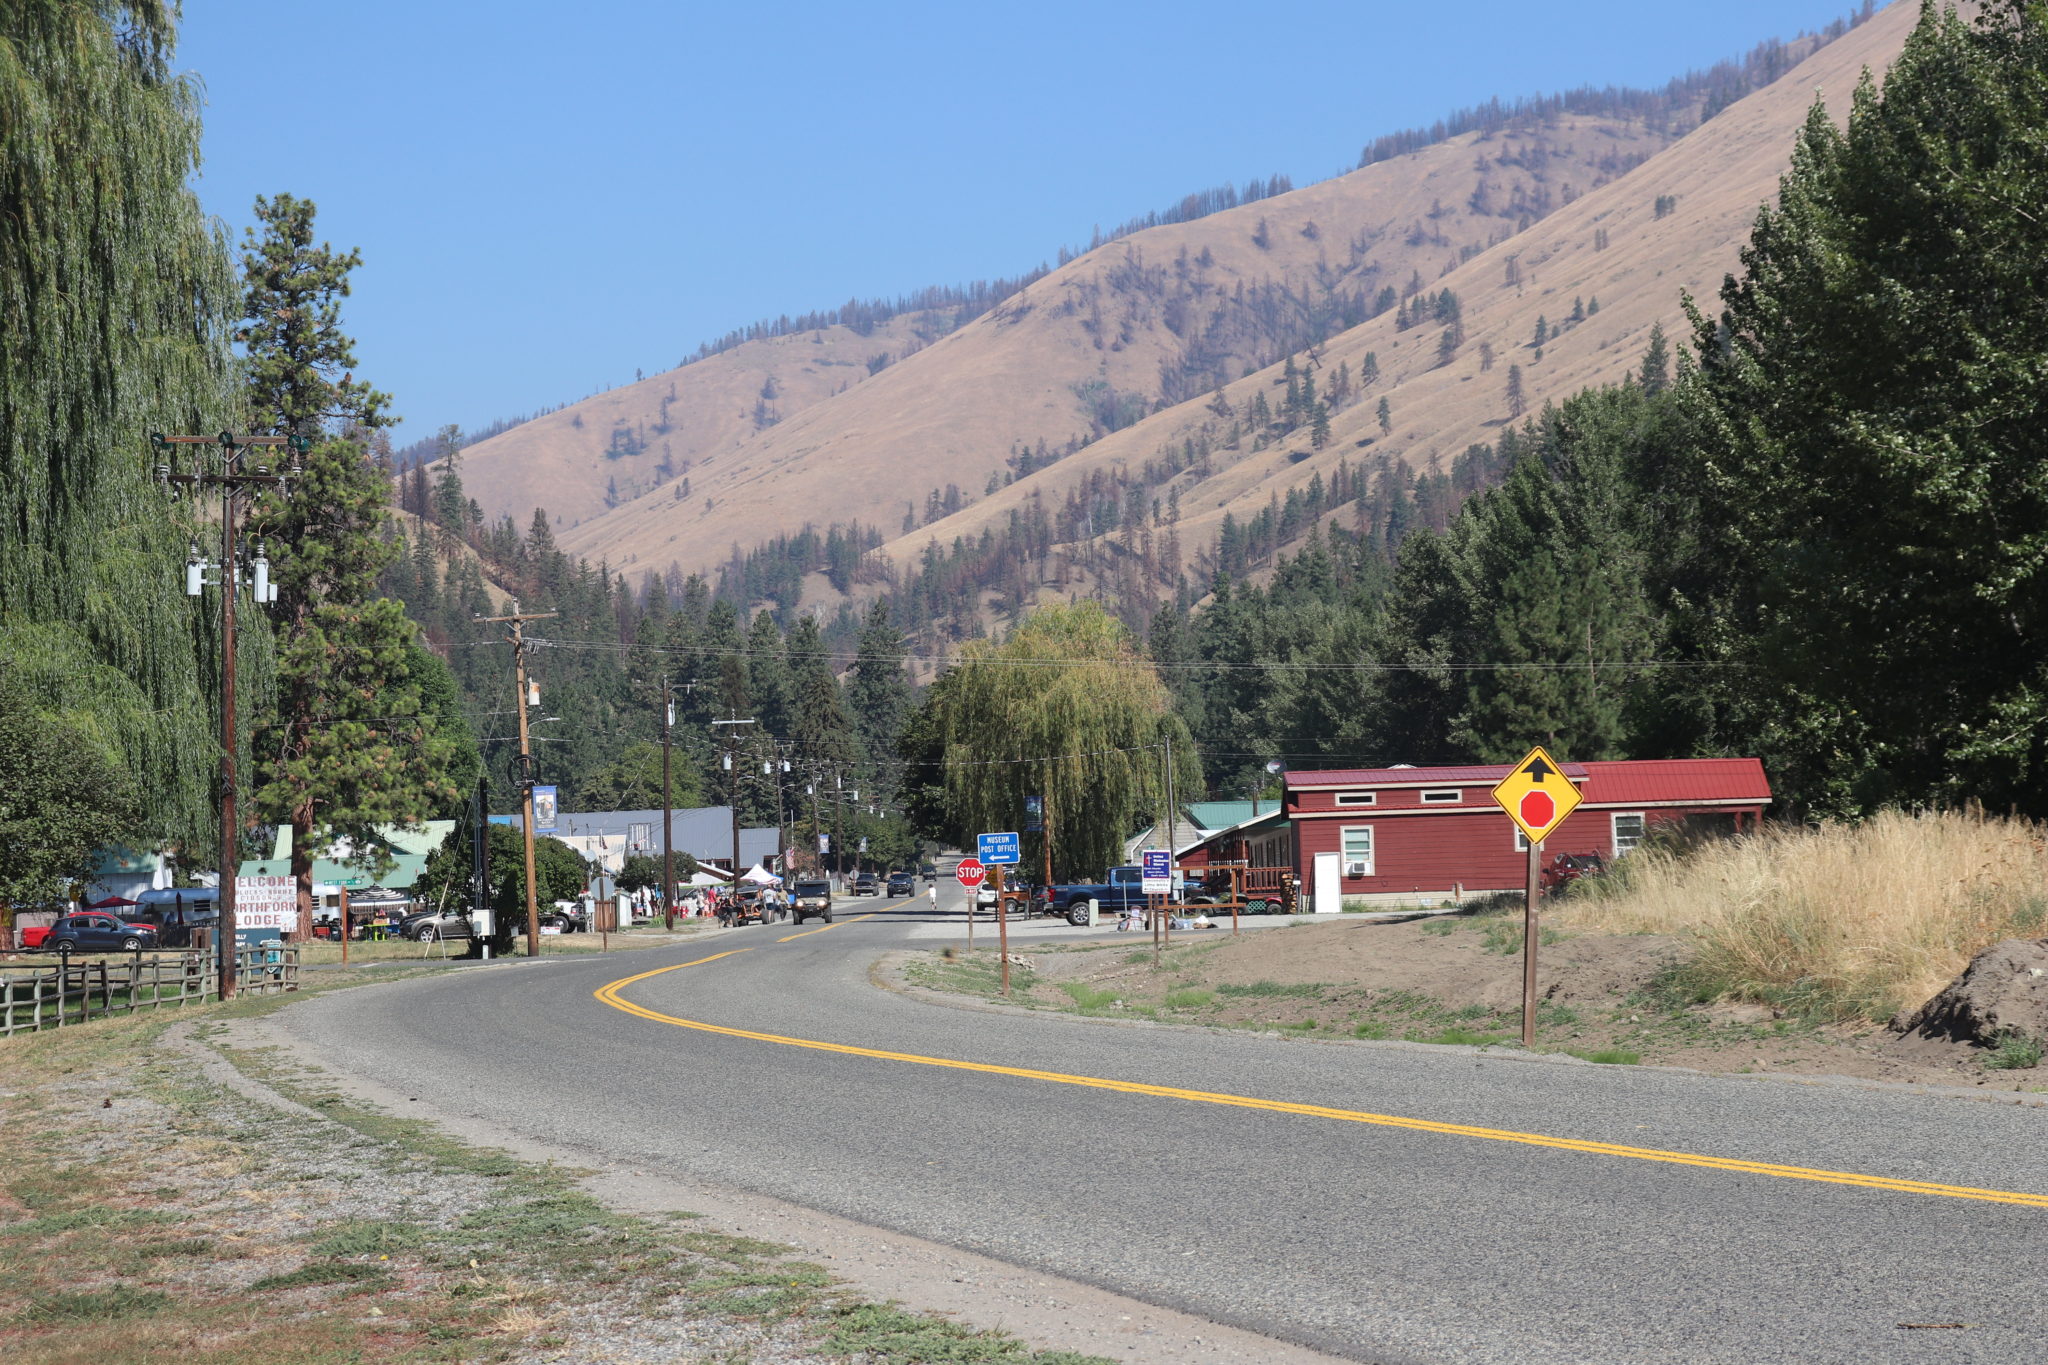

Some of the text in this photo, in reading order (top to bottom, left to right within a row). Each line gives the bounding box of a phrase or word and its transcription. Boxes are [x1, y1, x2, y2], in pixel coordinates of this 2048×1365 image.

[958, 867, 983, 878] STOP
[238, 876, 296, 887] ELCOME
[235, 902, 296, 912] ORTHFORK
